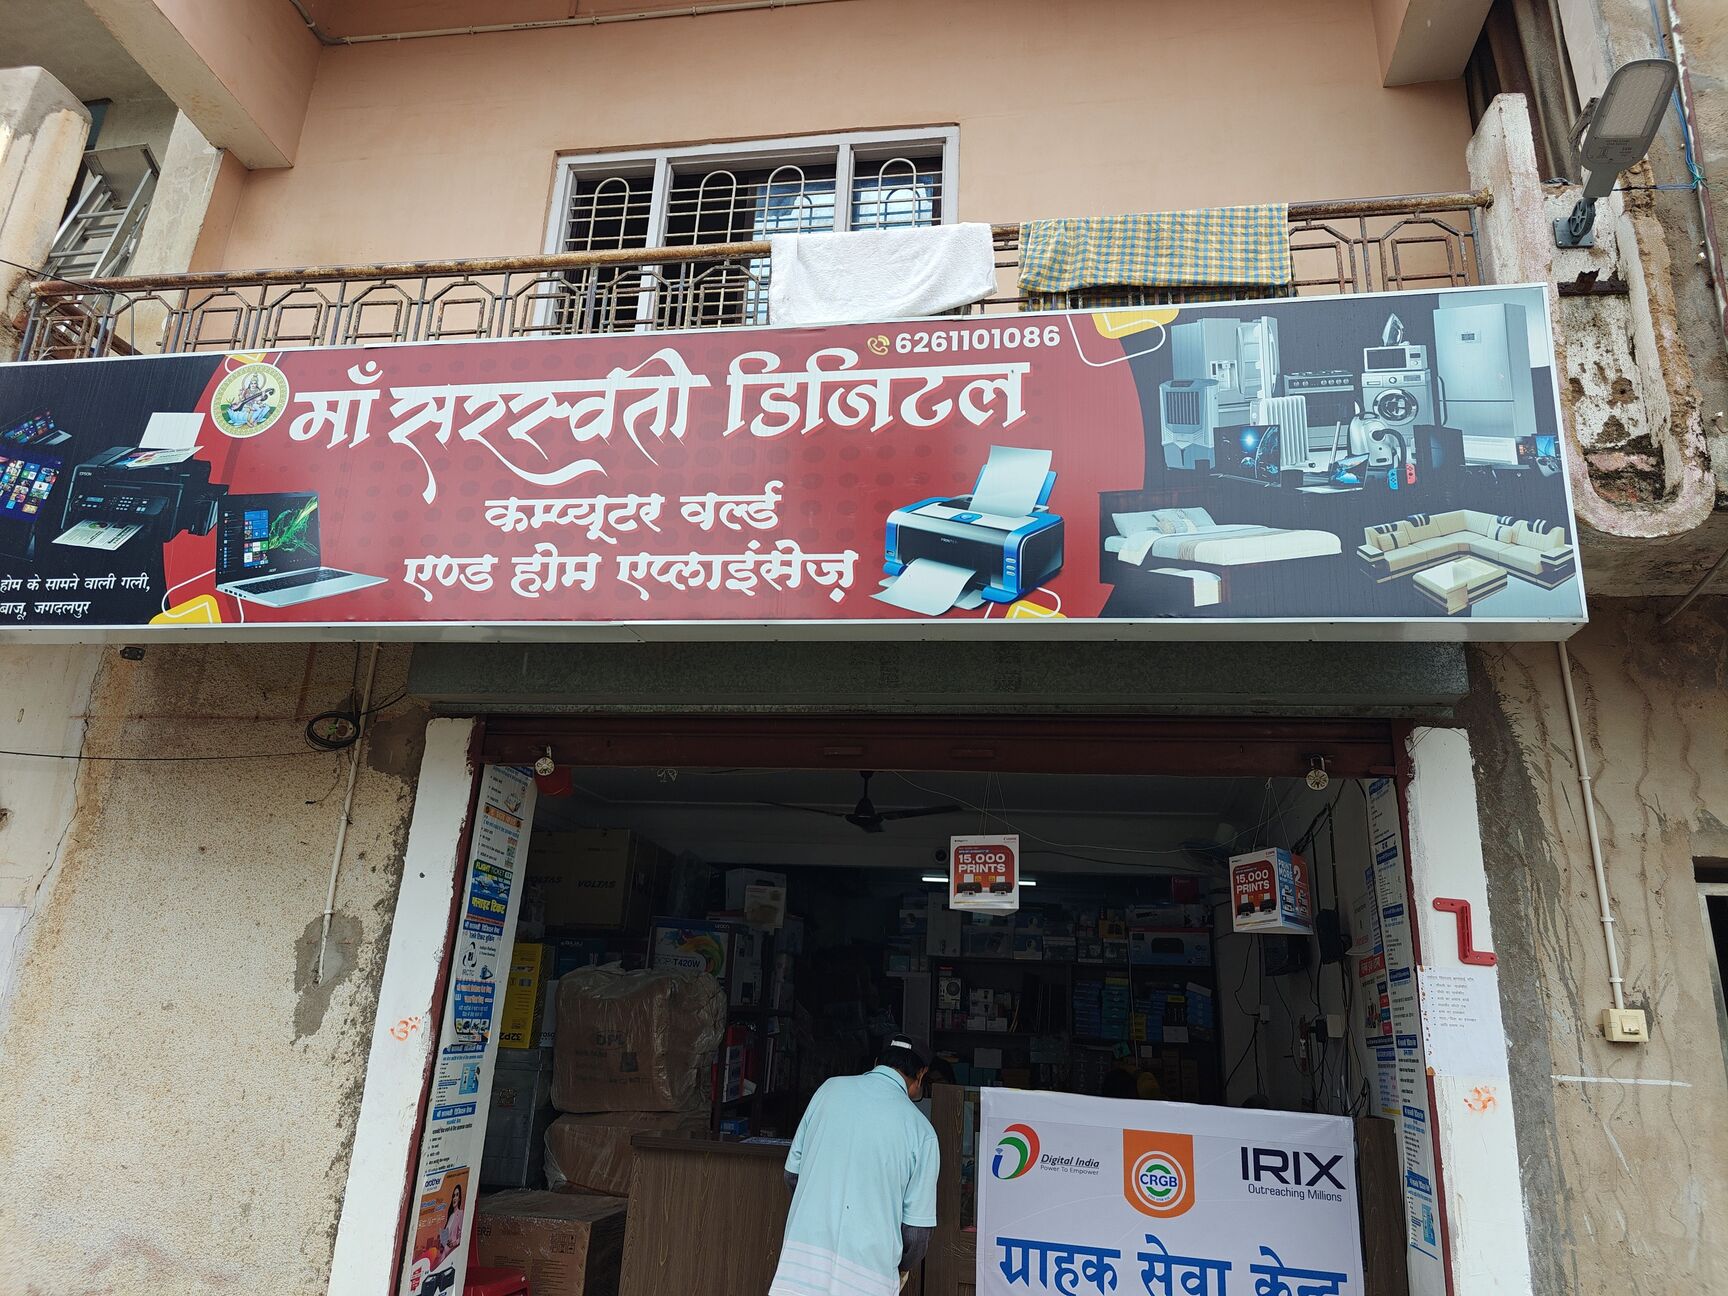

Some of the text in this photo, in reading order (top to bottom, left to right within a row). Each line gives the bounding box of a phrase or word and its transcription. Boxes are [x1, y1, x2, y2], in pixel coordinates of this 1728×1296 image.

[894, 325, 1061, 354] 6261101086
[289, 347, 1031, 504] माँ सरस्वती डिजिटल
[485, 480, 784, 545] कम्प्यूटर वर्ल्ड
[403, 553, 499, 602] एण्ड
[511, 542, 602, 599] होम
[0, 572, 151, 593] होम के सामने वाली गली,
[34, 601, 92, 619] जगदलपुर
[958, 853, 1006, 864] 15,000
[958, 863, 1006, 873] PRINTS
[1236, 880, 1270, 895] PRINTS
[1041, 1153, 1100, 1168] Digital India
[1240, 1146, 1347, 1190] IRIX
[1069, 1167, 1099, 1175] Empower
[1139, 1173, 1178, 1188] CRGB
[1247, 1183, 1343, 1202] Outreaching Millions
[996, 1237, 1121, 1296] ग्राहक
[1137, 1233, 1232, 1296] सेवा
